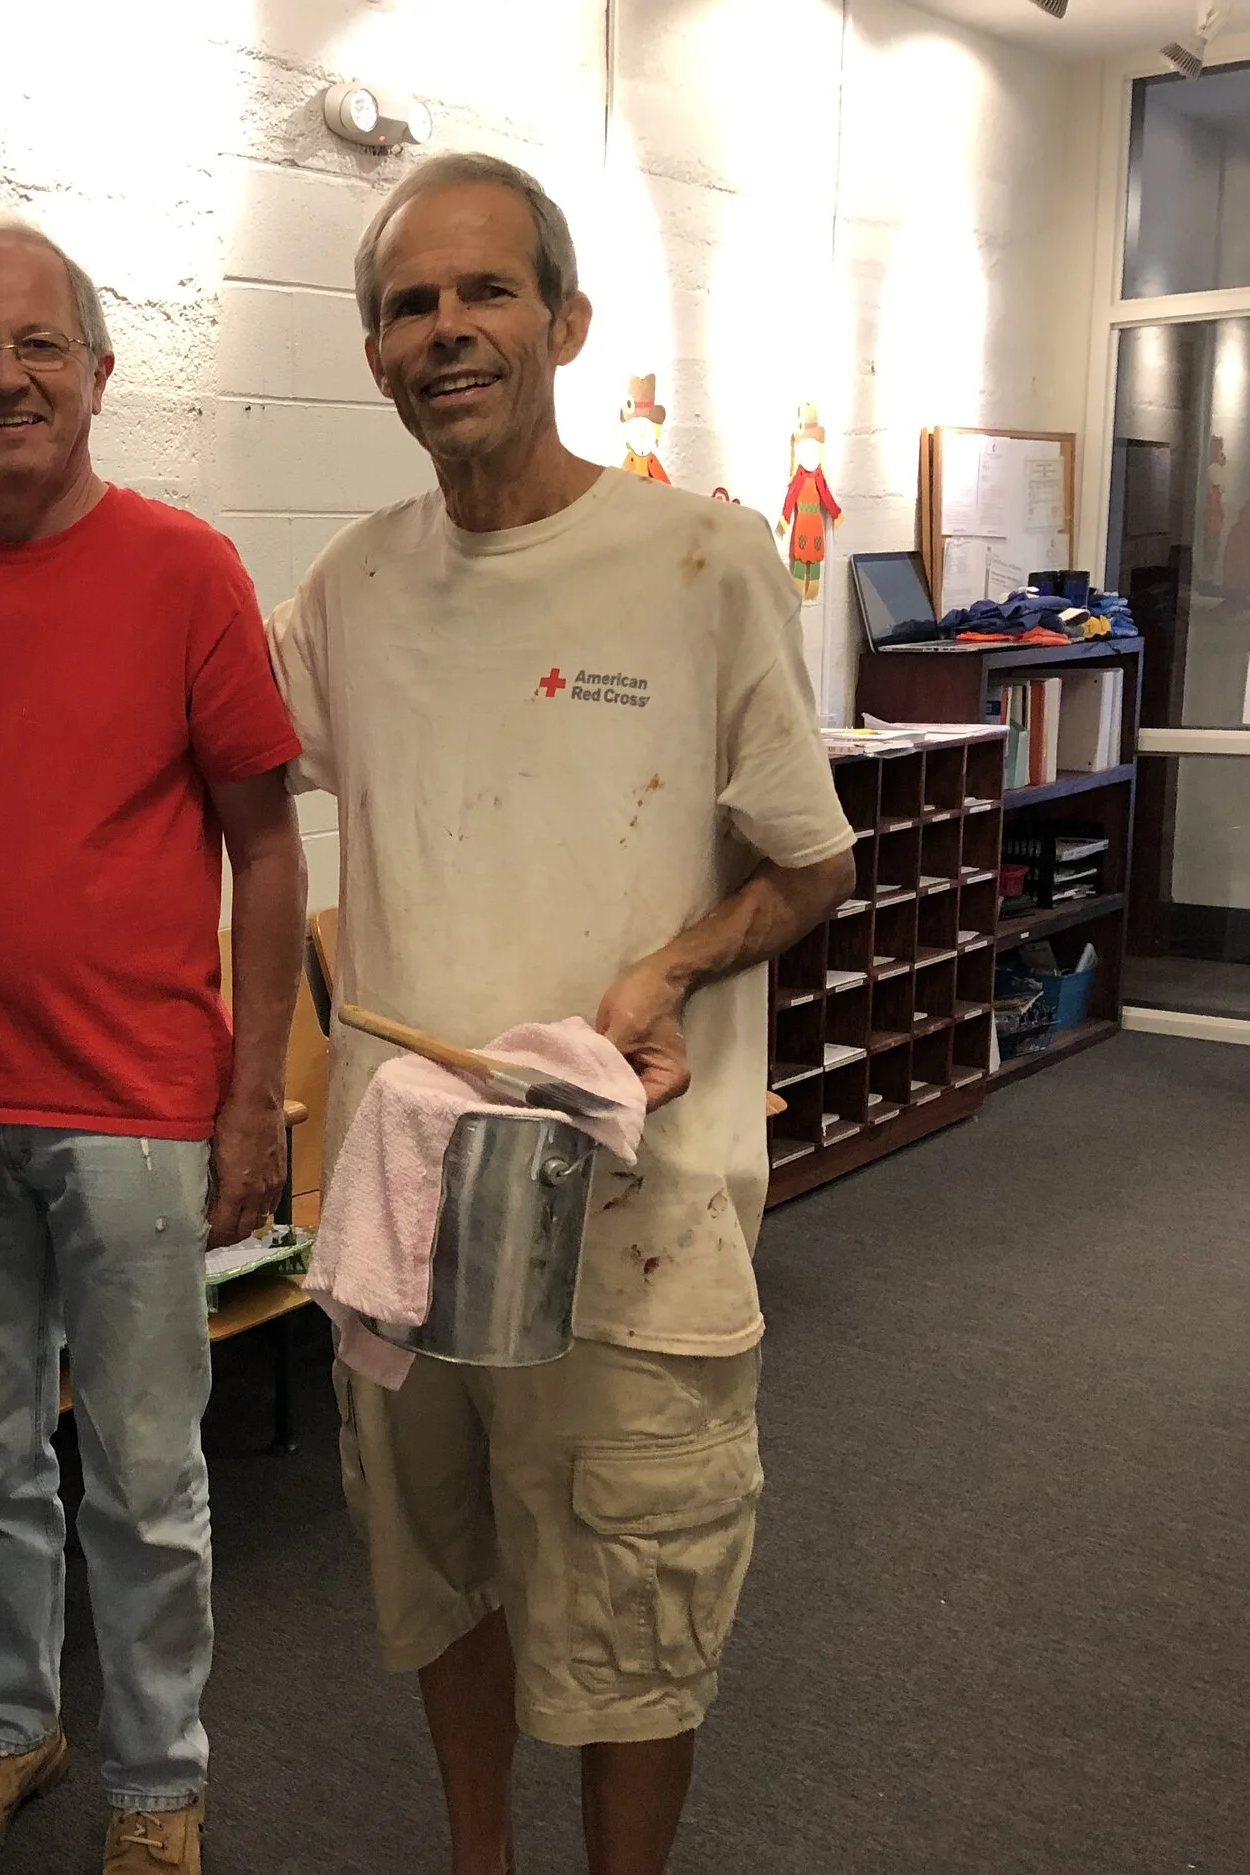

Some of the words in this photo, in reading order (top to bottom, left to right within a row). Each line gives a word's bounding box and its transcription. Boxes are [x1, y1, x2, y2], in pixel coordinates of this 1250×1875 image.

[574, 670, 648, 690] American
[571, 686, 602, 702] Red
[604, 688, 648, 708] Cross
